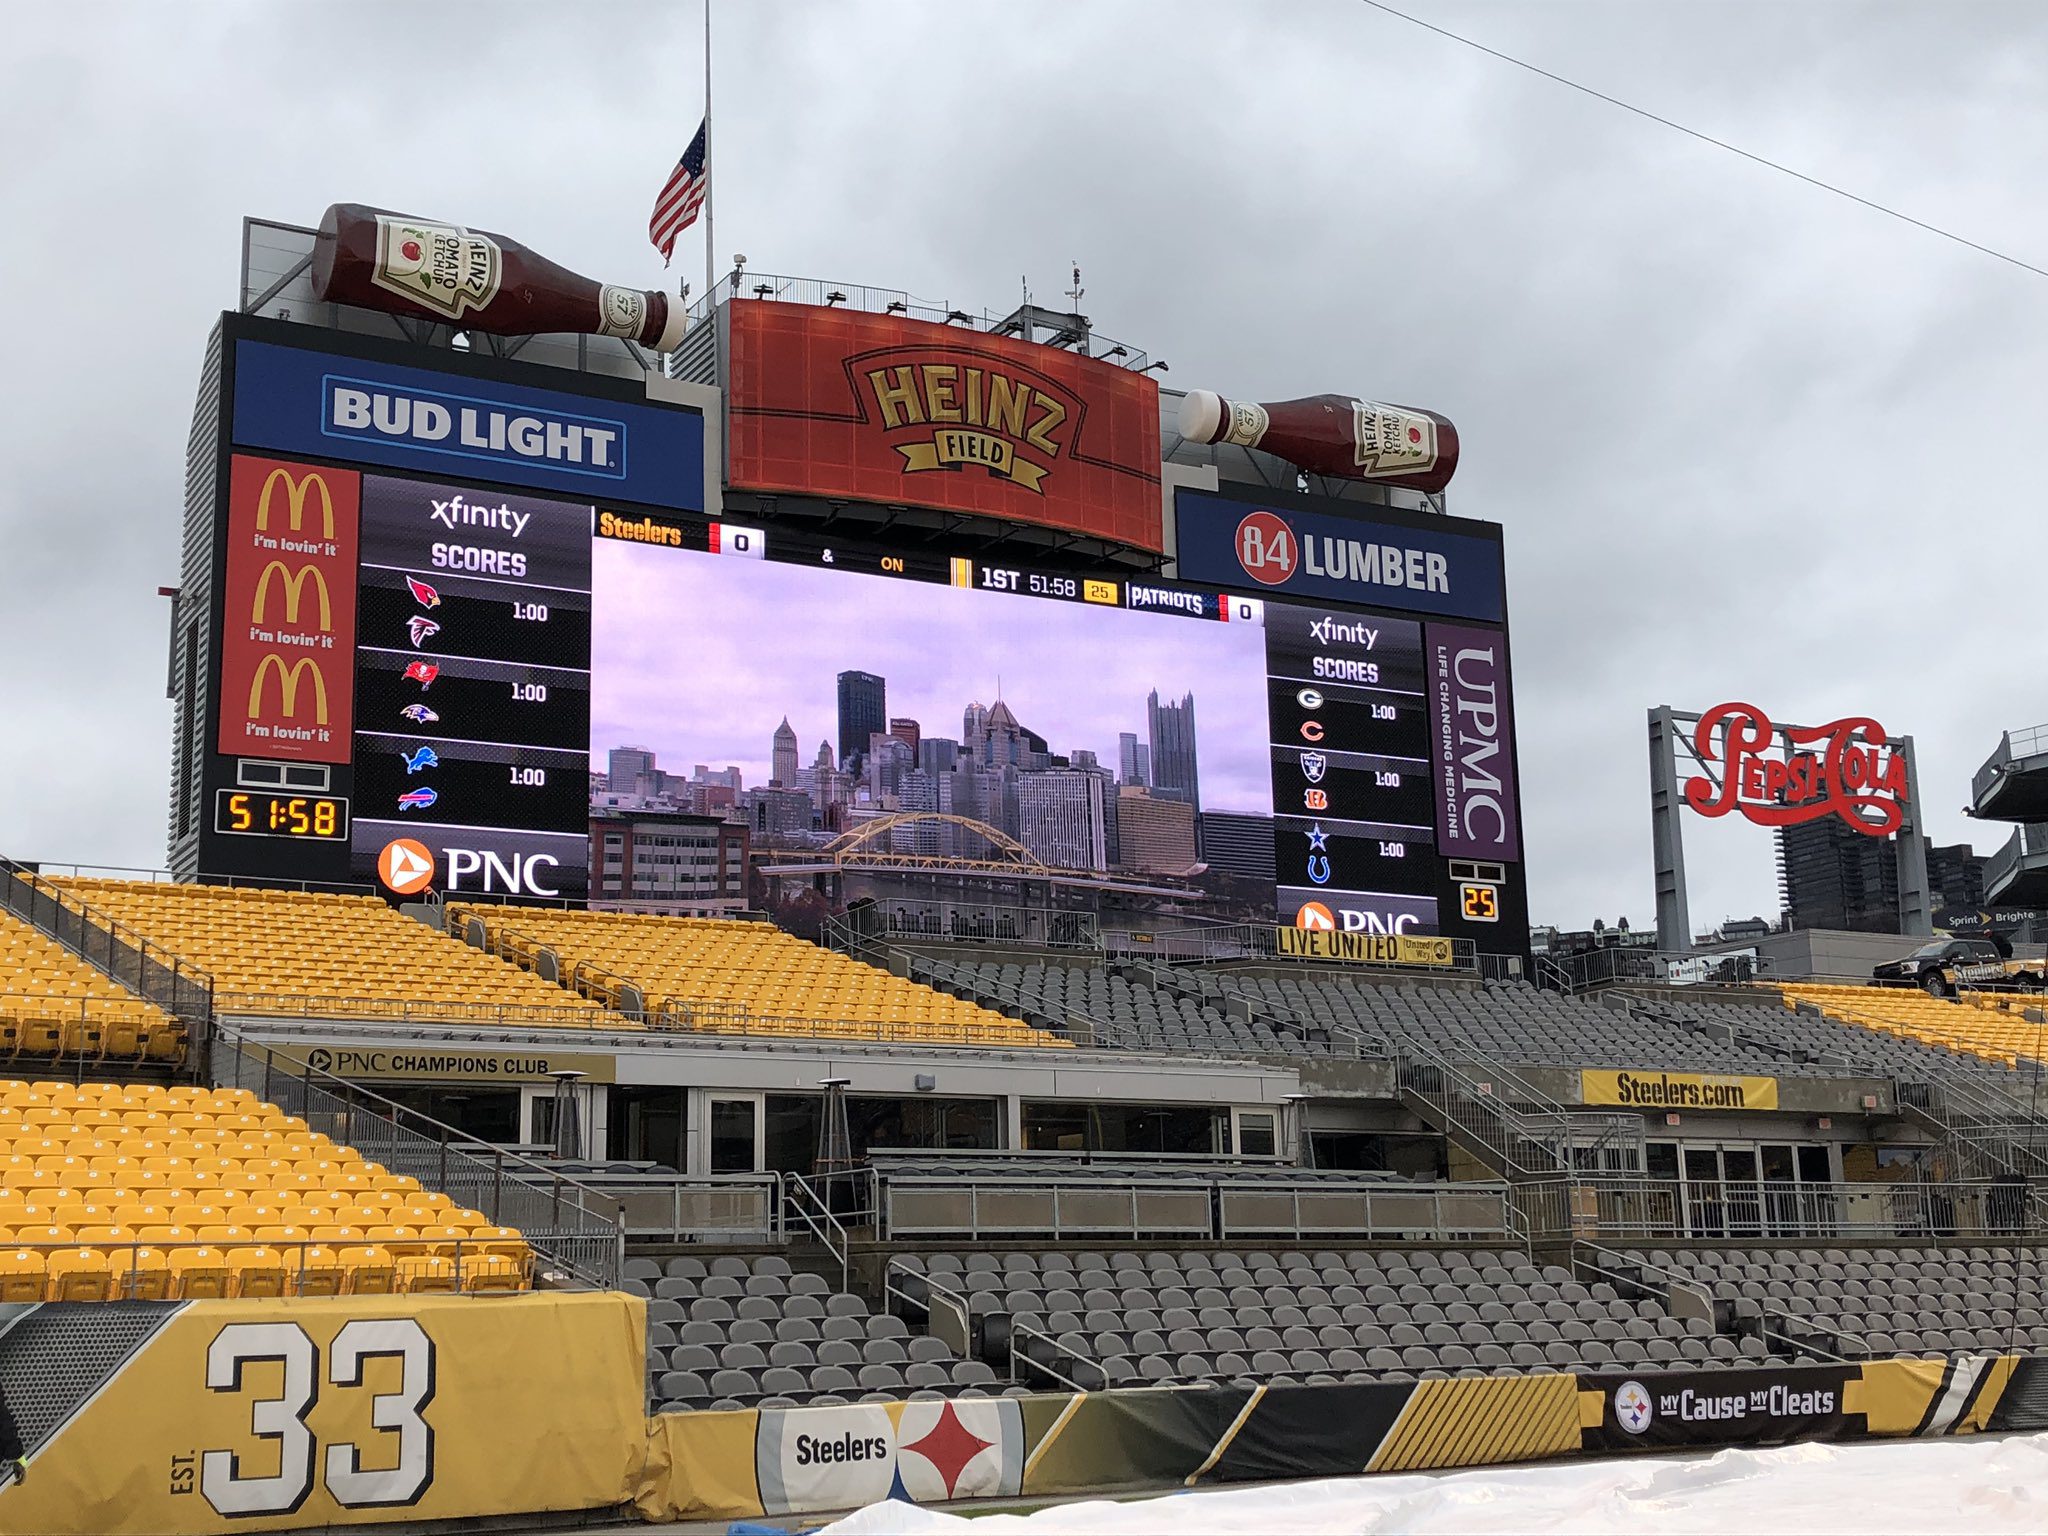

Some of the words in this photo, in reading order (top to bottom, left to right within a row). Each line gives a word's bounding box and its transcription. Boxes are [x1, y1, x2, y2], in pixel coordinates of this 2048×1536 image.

[465, 240, 486, 291] HEINZ
[616, 294, 629, 316] 57
[333, 387, 452, 442] BUD
[864, 363, 1068, 459] HEINZ
[1243, 408, 1255, 427] 57
[1364, 411, 1379, 452] HEINZ
[1381, 412, 1393, 456] TOMAT
[1391, 415, 1401, 455] KETCHU
[945, 434, 1005, 464] FIELD
[430, 495, 531, 538] xfinity
[600, 511, 683, 547] Steelers
[253, 533, 278, 549] i'm
[324, 541, 337, 557] it
[734, 534, 750, 552] 0
[431, 542, 527, 578] SCORES
[821, 548, 834, 563] &
[880, 556, 904, 573] ON
[1243, 525, 1290, 572] 84
[1304, 533, 1450, 594] LUMBER
[982, 566, 1021, 591] 1ST
[1028, 574, 1077, 598] 51:58
[1090, 585, 1110, 600] 25
[512, 602, 549, 622] 1:00
[1131, 586, 1204, 616] PATRIOTS
[1239, 604, 1252, 620] 0
[249, 627, 274, 643] i'm
[320, 635, 334, 649] it
[1309, 616, 1378, 650] xfinity
[1312, 656, 1379, 684] SCORES
[1437, 645, 1448, 678] LIFE
[511, 682, 547, 702] 1:00
[1370, 704, 1396, 721] 1:00
[1439, 681, 1453, 762] CHANGING
[245, 722, 271, 737] i'm
[317, 728, 331, 743] it
[1454, 646, 1506, 843] UPMC
[509, 766, 546, 787] 1:00
[1374, 772, 1400, 788] 1:00
[1444, 765, 1458, 839] MEDICINE
[1379, 843, 1404, 858] 1:00
[442, 848, 560, 896] PNC
[1464, 888, 1495, 917] 25
[1338, 909, 1420, 937] PNC
[1949, 915, 1978, 927] Sprint
[1995, 911, 2036, 922] Brighte
[1278, 927, 1322, 956] LIVE
[1405, 939, 1430, 950] United
[1953, 961, 2005, 983] Steelers
[336, 1052, 387, 1072] PNC
[391, 1055, 498, 1073] CHAMPIONS
[503, 1058, 549, 1074] CLUB
[1617, 1072, 1745, 1107] Steelers.com
[200, 1318, 436, 1518] 33
[1660, 1394, 1680, 1416] MY
[1681, 1389, 1746, 1421] Cause
[1750, 1390, 1769, 1411] MY
[1769, 1385, 1834, 1416] Cleats
[796, 1433, 888, 1466] Steelers
[170, 1449, 195, 1495] EST.
